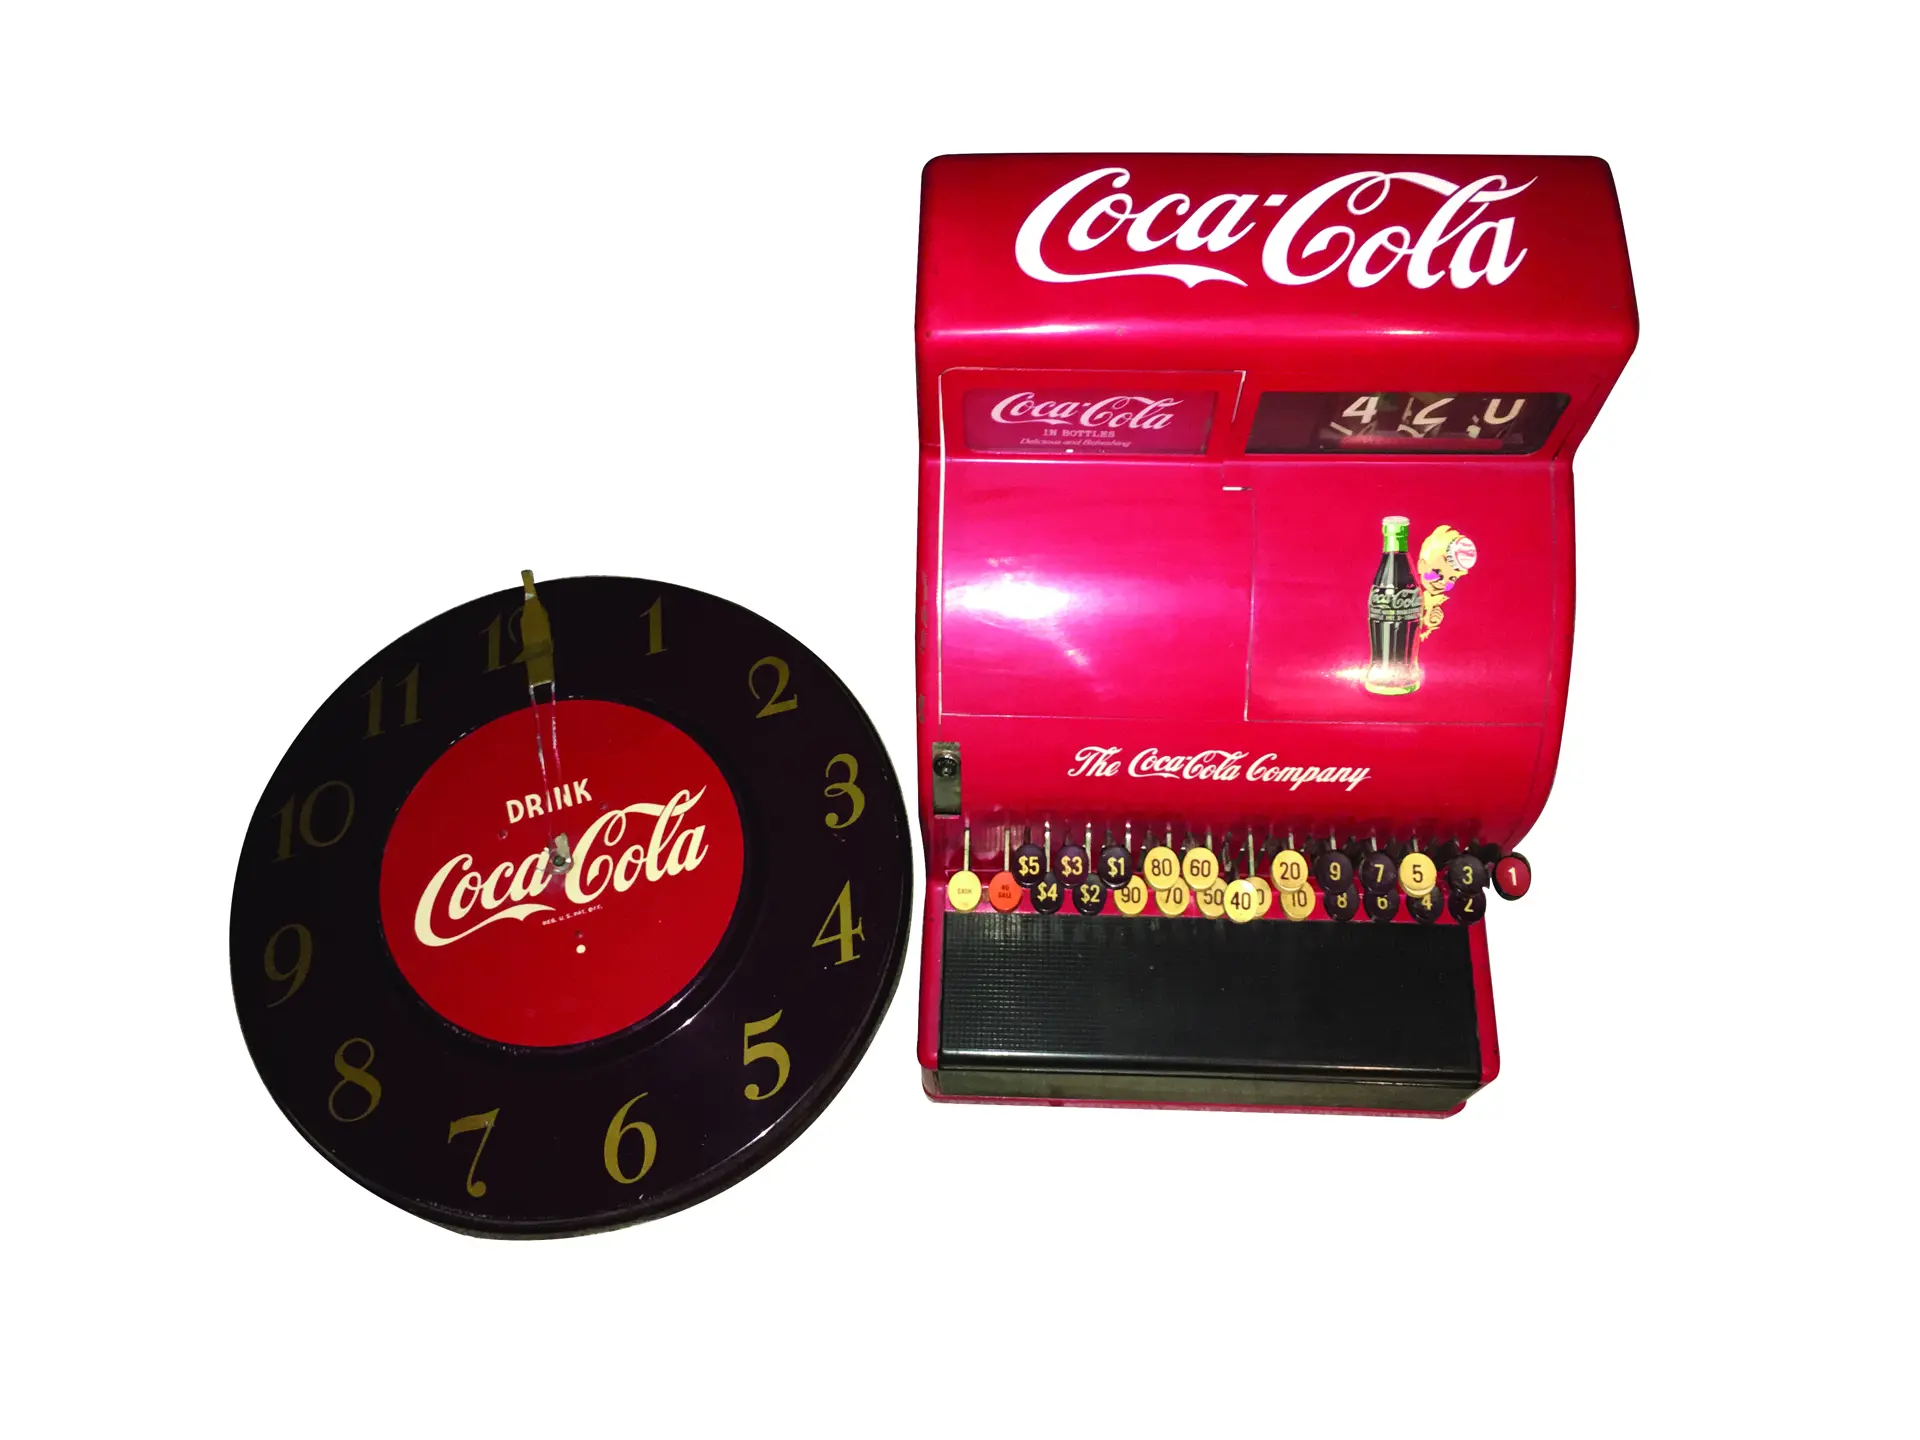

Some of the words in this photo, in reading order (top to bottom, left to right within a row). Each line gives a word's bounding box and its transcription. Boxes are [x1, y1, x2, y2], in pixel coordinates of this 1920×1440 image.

[1014, 167, 1538, 289] Coca-Cola
[991, 391, 1184, 430] Coca-Cola
[1020, 438, 1061, 446] Delicious
[1083, 439, 1132, 448] Refreshing
[1043, 428, 1057, 437] IN
[1062, 429, 1115, 438] BOTTLES
[640, 596, 668, 656] 1
[748, 656, 799, 719] 2
[361, 662, 424, 740] 11
[1067, 745, 1123, 777] The
[1127, 747, 1249, 781] Coca-Cola
[1245, 752, 1372, 792] Company
[505, 778, 593, 824] DRINK
[824, 753, 866, 830] 3
[271, 780, 356, 864] 10
[414, 784, 709, 947] CocaCola
[1018, 855, 1040, 876] $5
[1060, 855, 1083, 877] $3
[1107, 856, 1125, 877] $1
[1151, 858, 1172, 876] 80
[1190, 859, 1211, 877] 60
[1279, 861, 1301, 880] 20
[1329, 861, 1341, 881] 9
[1373, 864, 1385, 883] 7
[1412, 864, 1424, 883] 5
[1462, 865, 1474, 885] 3
[1507, 867, 1518, 886] 1
[1037, 881, 1058, 902] $4
[1079, 884, 1100, 904] $2
[1120, 886, 1142, 903] 90
[1203, 887, 1224, 906] 50
[1230, 891, 1252, 910] 40
[811, 880, 867, 966] 4
[264, 924, 313, 1008] 9
[743, 1009, 792, 1102] 5
[328, 1037, 384, 1123] 8
[603, 1092, 658, 1186] 6
[447, 1108, 501, 1199] 7
